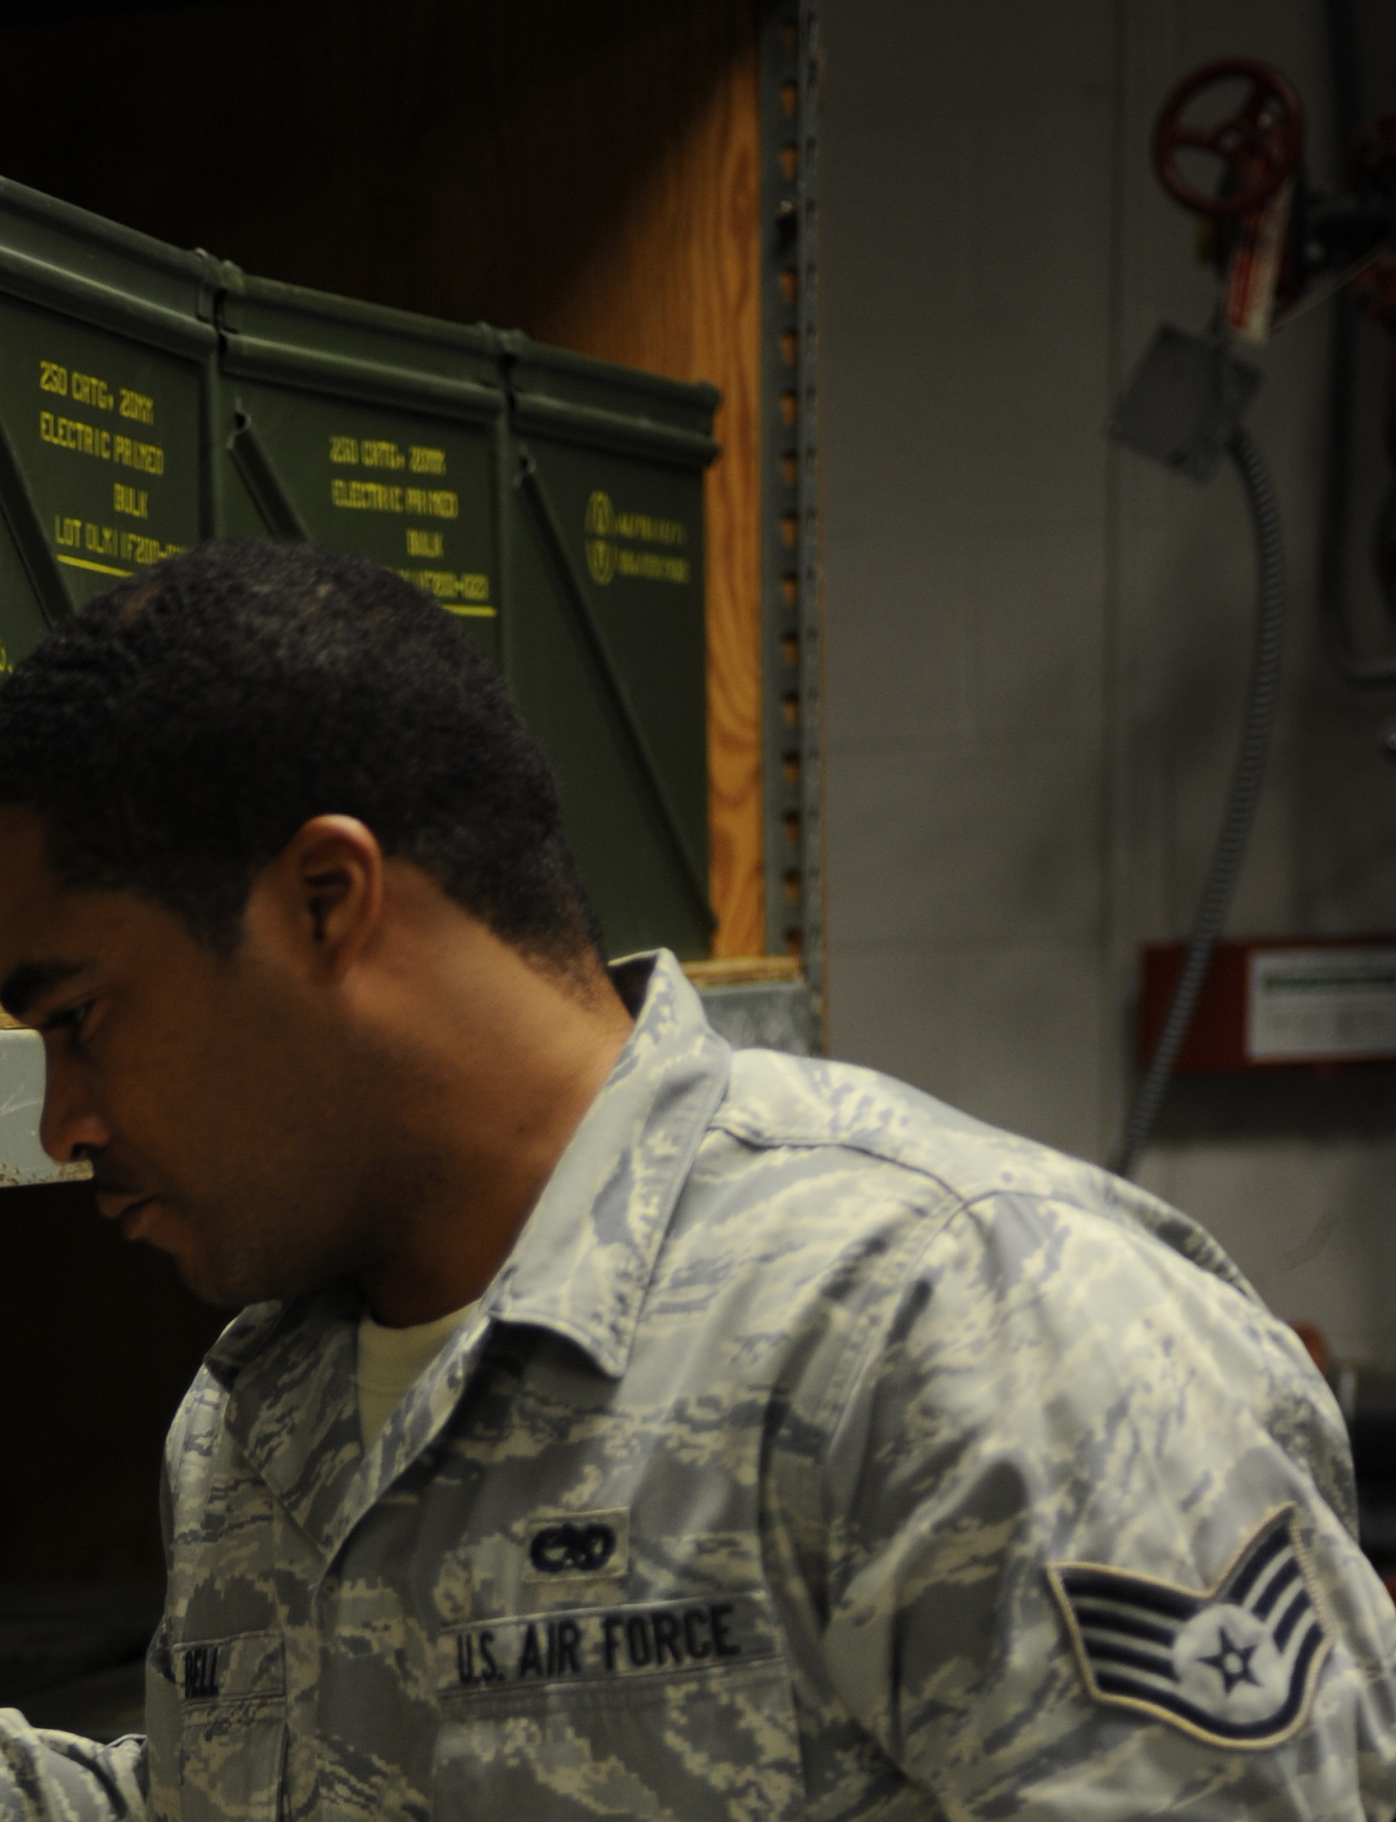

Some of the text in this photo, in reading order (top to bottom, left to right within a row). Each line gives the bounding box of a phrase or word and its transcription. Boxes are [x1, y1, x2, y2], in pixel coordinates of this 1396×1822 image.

[40, 410, 165, 475] ELECTRIC PRIMED
[113, 482, 149, 519] BULK
[331, 478, 404, 513] ELECTRIC
[55, 515, 82, 548] LOT
[406, 528, 444, 559] BULK
[457, 1604, 741, 1684] U.S. AIR FORCE
